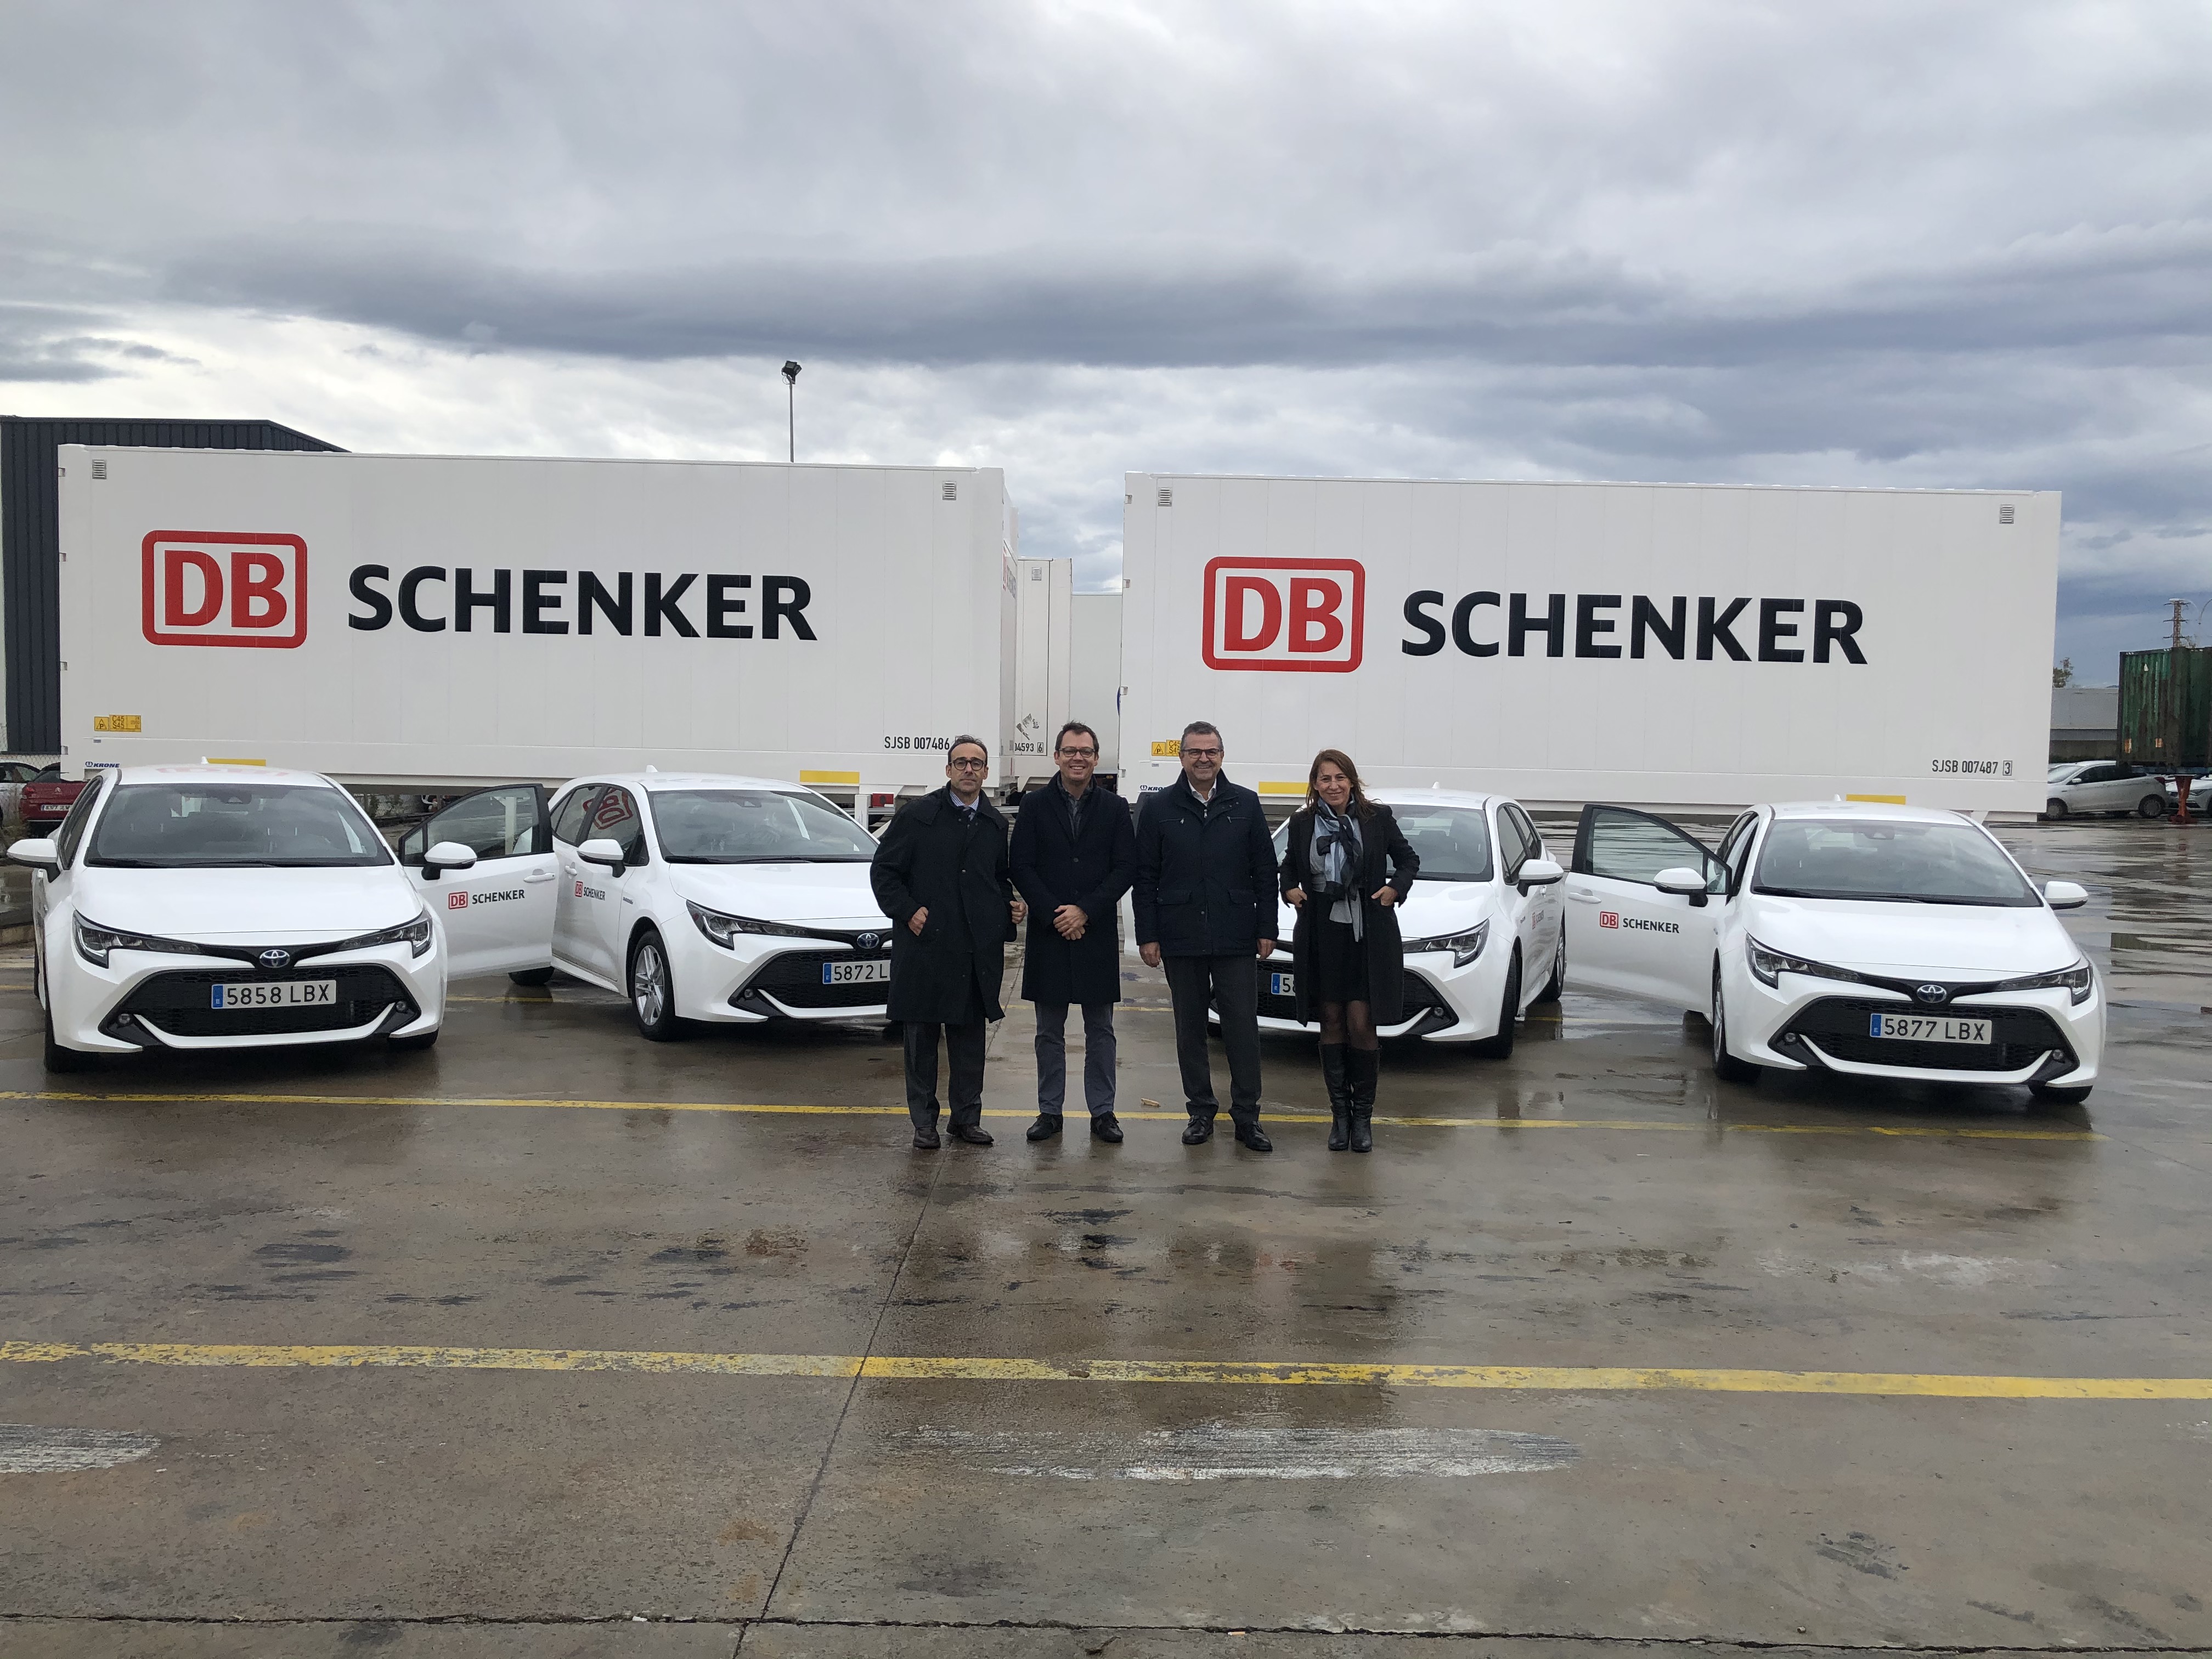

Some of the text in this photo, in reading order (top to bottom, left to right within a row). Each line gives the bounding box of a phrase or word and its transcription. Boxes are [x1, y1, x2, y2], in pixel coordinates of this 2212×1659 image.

[165, 550, 817, 641] DB SCHENKER
[1224, 576, 1868, 664] DB SCHENKER
[884, 736, 950, 750] SJSB 007486
[1038, 743, 1042, 752] 6
[1932, 760, 2011, 775] SJSB 007487 3
[451, 889, 525, 906] DB SCHENKER
[575, 884, 605, 900] DB SCHENKER
[1602, 914, 1679, 933] DB SCHENKER
[834, 964, 874, 981] 5872
[1283, 977, 1295, 993] 5
[227, 984, 329, 1005] 5858 LBX
[1884, 1018, 1985, 1041] 5877 LBX
